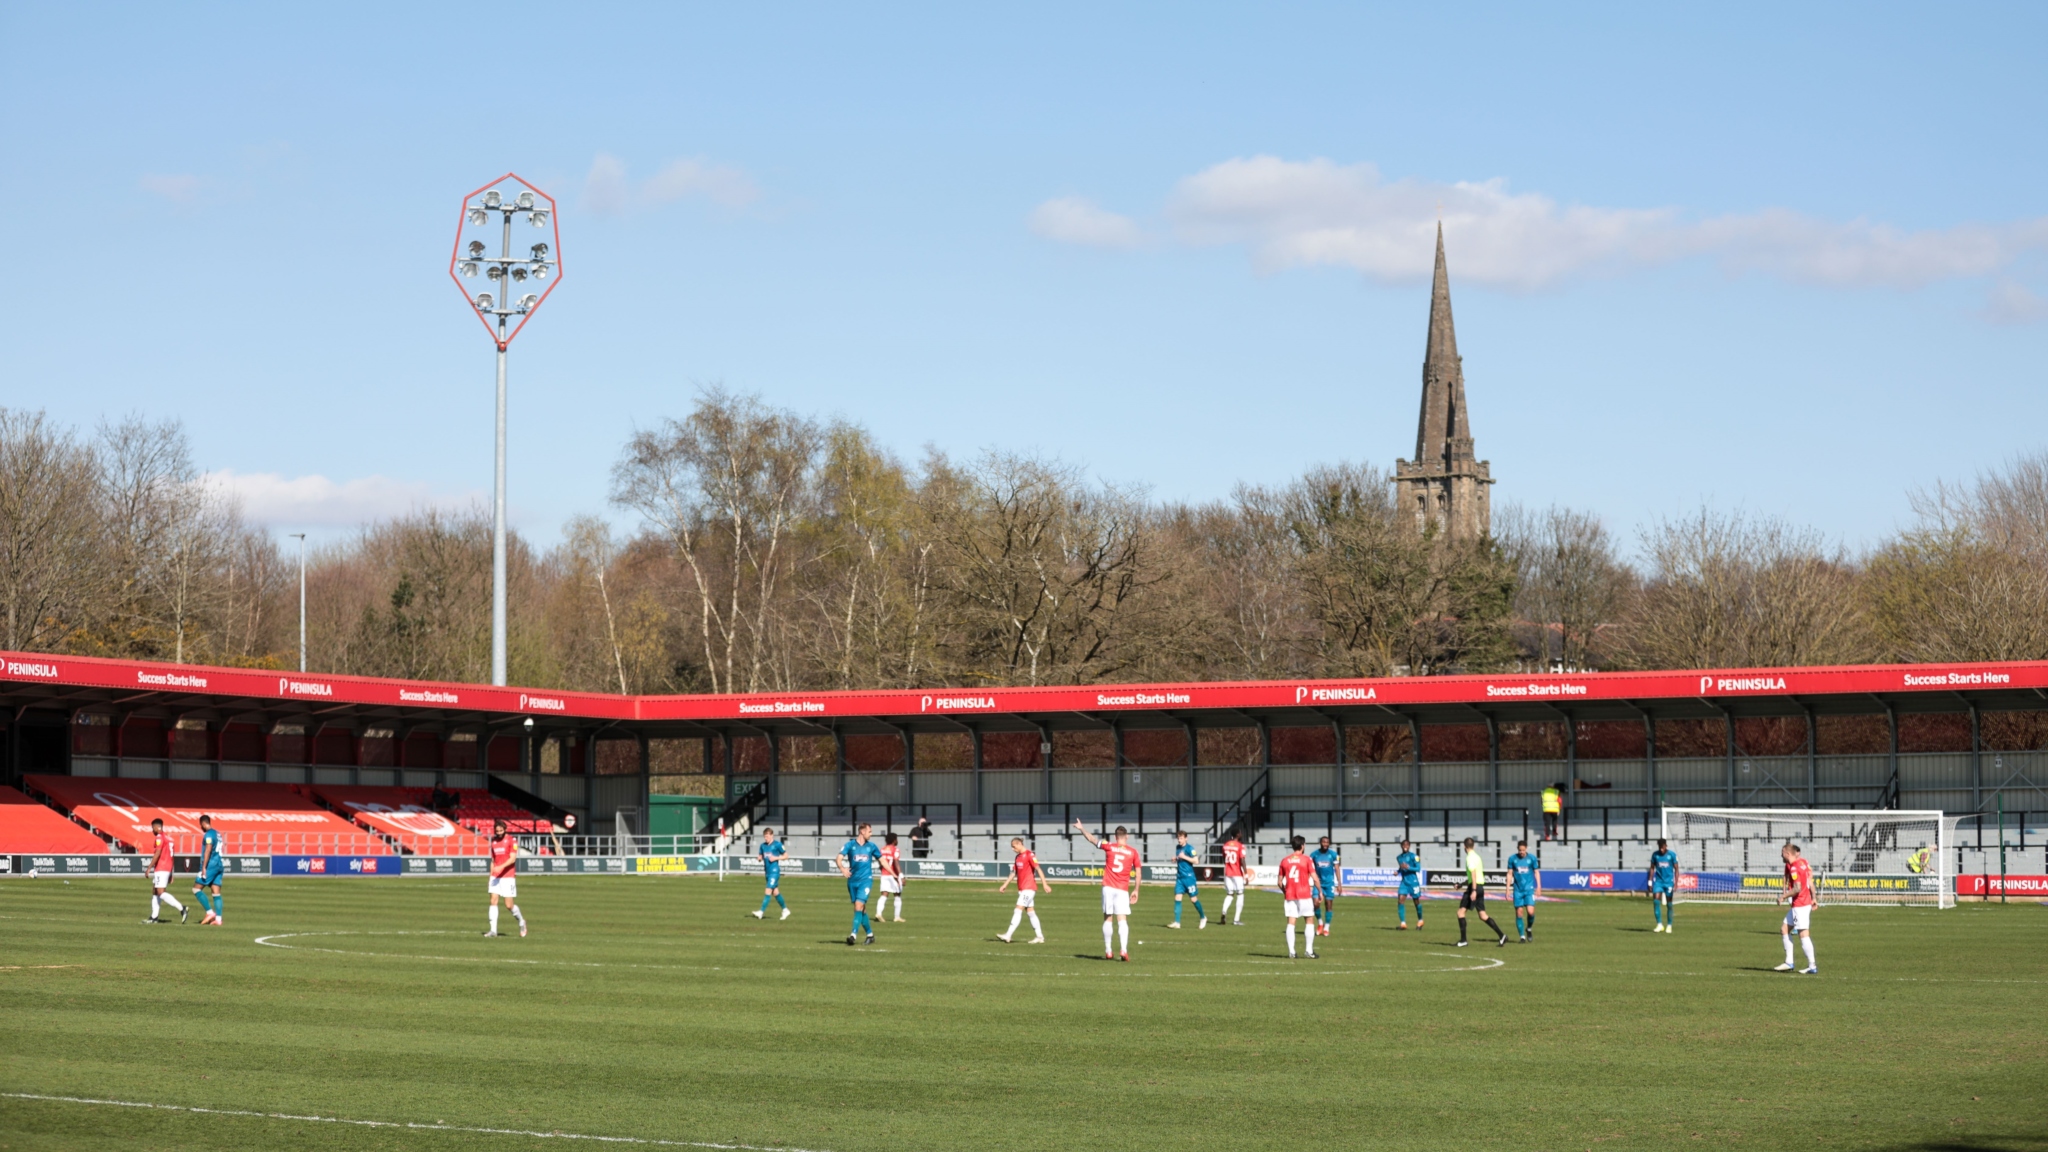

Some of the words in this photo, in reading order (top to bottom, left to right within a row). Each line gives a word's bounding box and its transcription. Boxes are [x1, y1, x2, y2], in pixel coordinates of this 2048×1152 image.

[8, 662, 58, 677] PENINSULA
[137, 671, 167, 685] Success
[167, 673, 189, 687] Starts
[189, 675, 207, 688] Here
[1717, 678, 1786, 691] PENINSULA
[1904, 673, 1947, 686] Success
[1948, 672, 1982, 684] Starts
[1983, 672, 2010, 683] Here
[290, 682, 332, 696] PENINSULA
[1312, 688, 1376, 700] PENINSULA
[1487, 685, 1527, 697] Success
[1528, 684, 1560, 695] Starts
[1561, 683, 1587, 695] Here
[400, 689, 424, 702] Success
[424, 690, 443, 703] Starts
[443, 692, 458, 704] Here
[936, 697, 995, 709] PENINSULA
[1097, 694, 1135, 706] Success
[1136, 693, 1165, 705] Starts
[1166, 692, 1190, 704] Here
[529, 697, 565, 710] PENINSULA
[739, 703, 774, 714] Success
[775, 702, 802, 713] Starts
[802, 702, 824, 712] Here
[32, 858, 55, 866] TalkTalk
[65, 858, 88, 866] TalkTalk
[109, 858, 131, 867] TalkTalk
[1112, 854, 1125, 873] 5
[1225, 850, 1239, 864] 20
[297, 858, 310, 873] sky
[311, 858, 325, 871] bet
[350, 858, 362, 873] sky
[363, 858, 377, 871] bet
[918, 862, 945, 870] TalkTalk
[958, 863, 985, 871] TalkTalk
[1056, 867, 1082, 876] Search
[1083, 867, 1104, 877] TalkT
[1289, 866, 1299, 883] 4
[1569, 873, 1588, 887] sky
[1591, 873, 1611, 886] bet
[1743, 878, 1765, 887] GREAT
[1848, 880, 1867, 888] BACK
[1869, 880, 1879, 888] OF
[1880, 880, 1893, 888] THE
[1990, 880, 2048, 890] PENINSULA
